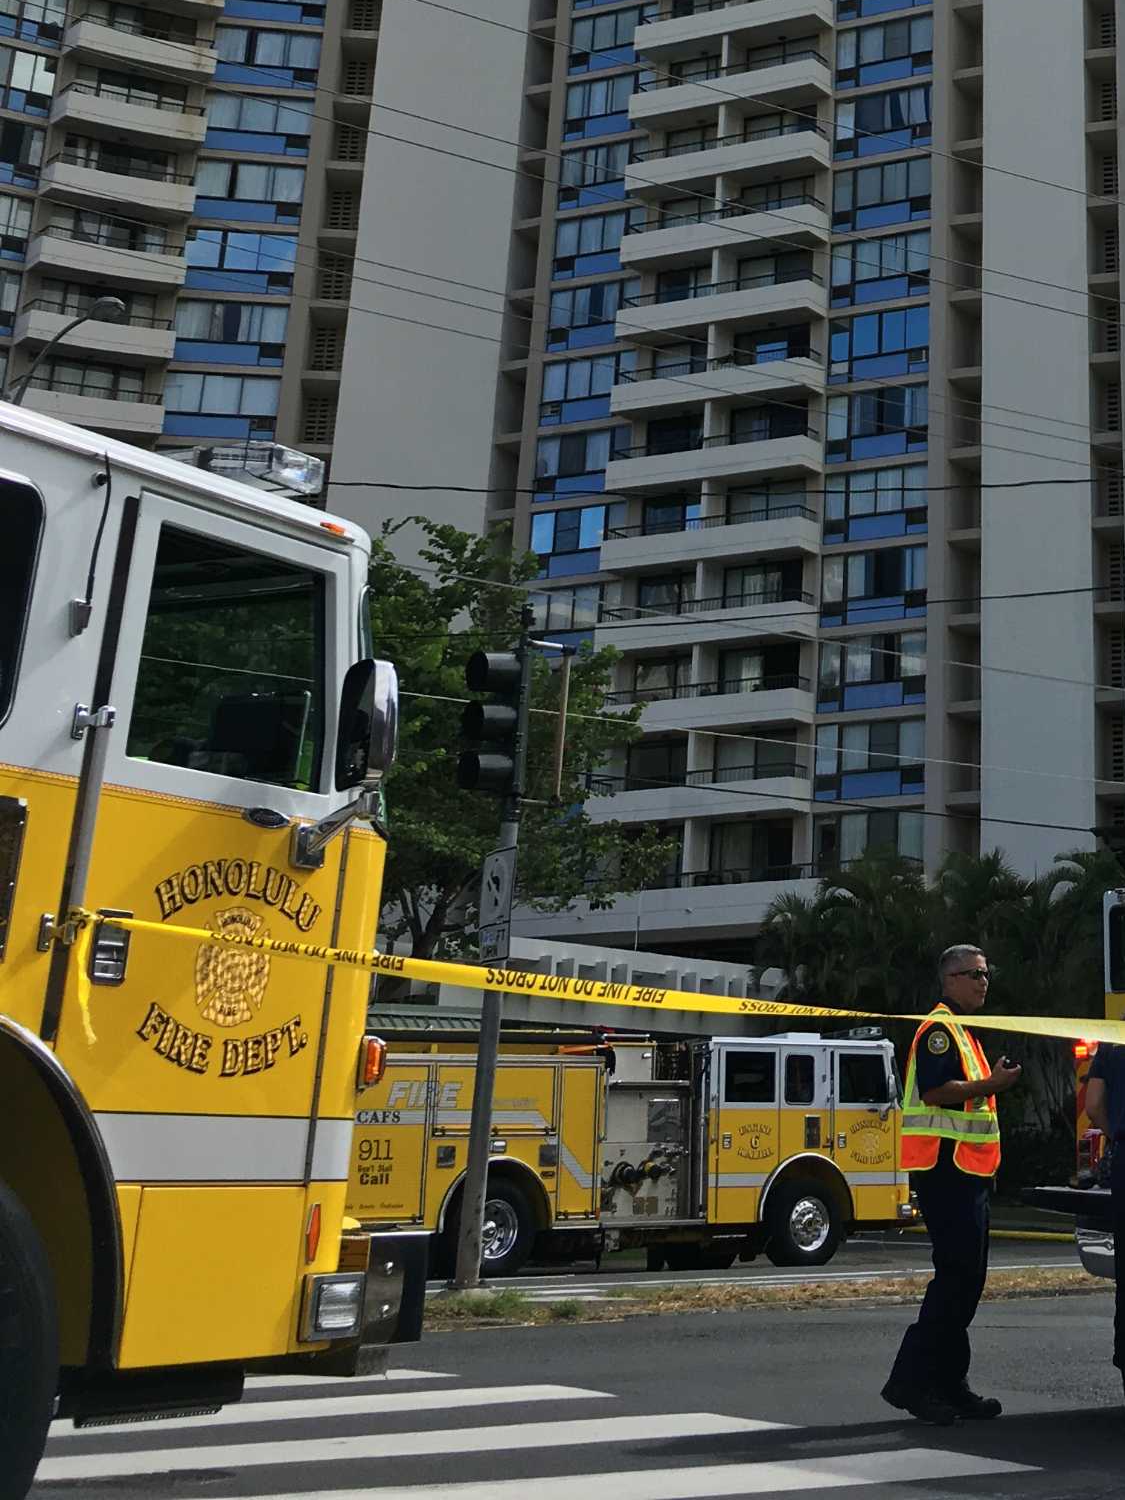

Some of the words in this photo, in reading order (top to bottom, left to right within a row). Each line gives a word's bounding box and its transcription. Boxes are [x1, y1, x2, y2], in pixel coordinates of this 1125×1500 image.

[155, 858, 321, 932] HONOLULU
[486, 968, 536, 989] CROSS
[540, 974, 569, 994] NOT
[574, 979, 595, 996] DO
[597, 981, 632, 1000] LINE
[633, 988, 666, 1003] FIRE
[739, 1001, 787, 1013] CROSS
[137, 1001, 212, 1075] FIRE
[219, 1014, 309, 1077] DEPT.
[357, 1110, 401, 1124] CAFS
[359, 1139, 393, 1161] 911
[751, 1135, 760, 1149] 6
[359, 1173, 390, 1186] Call
